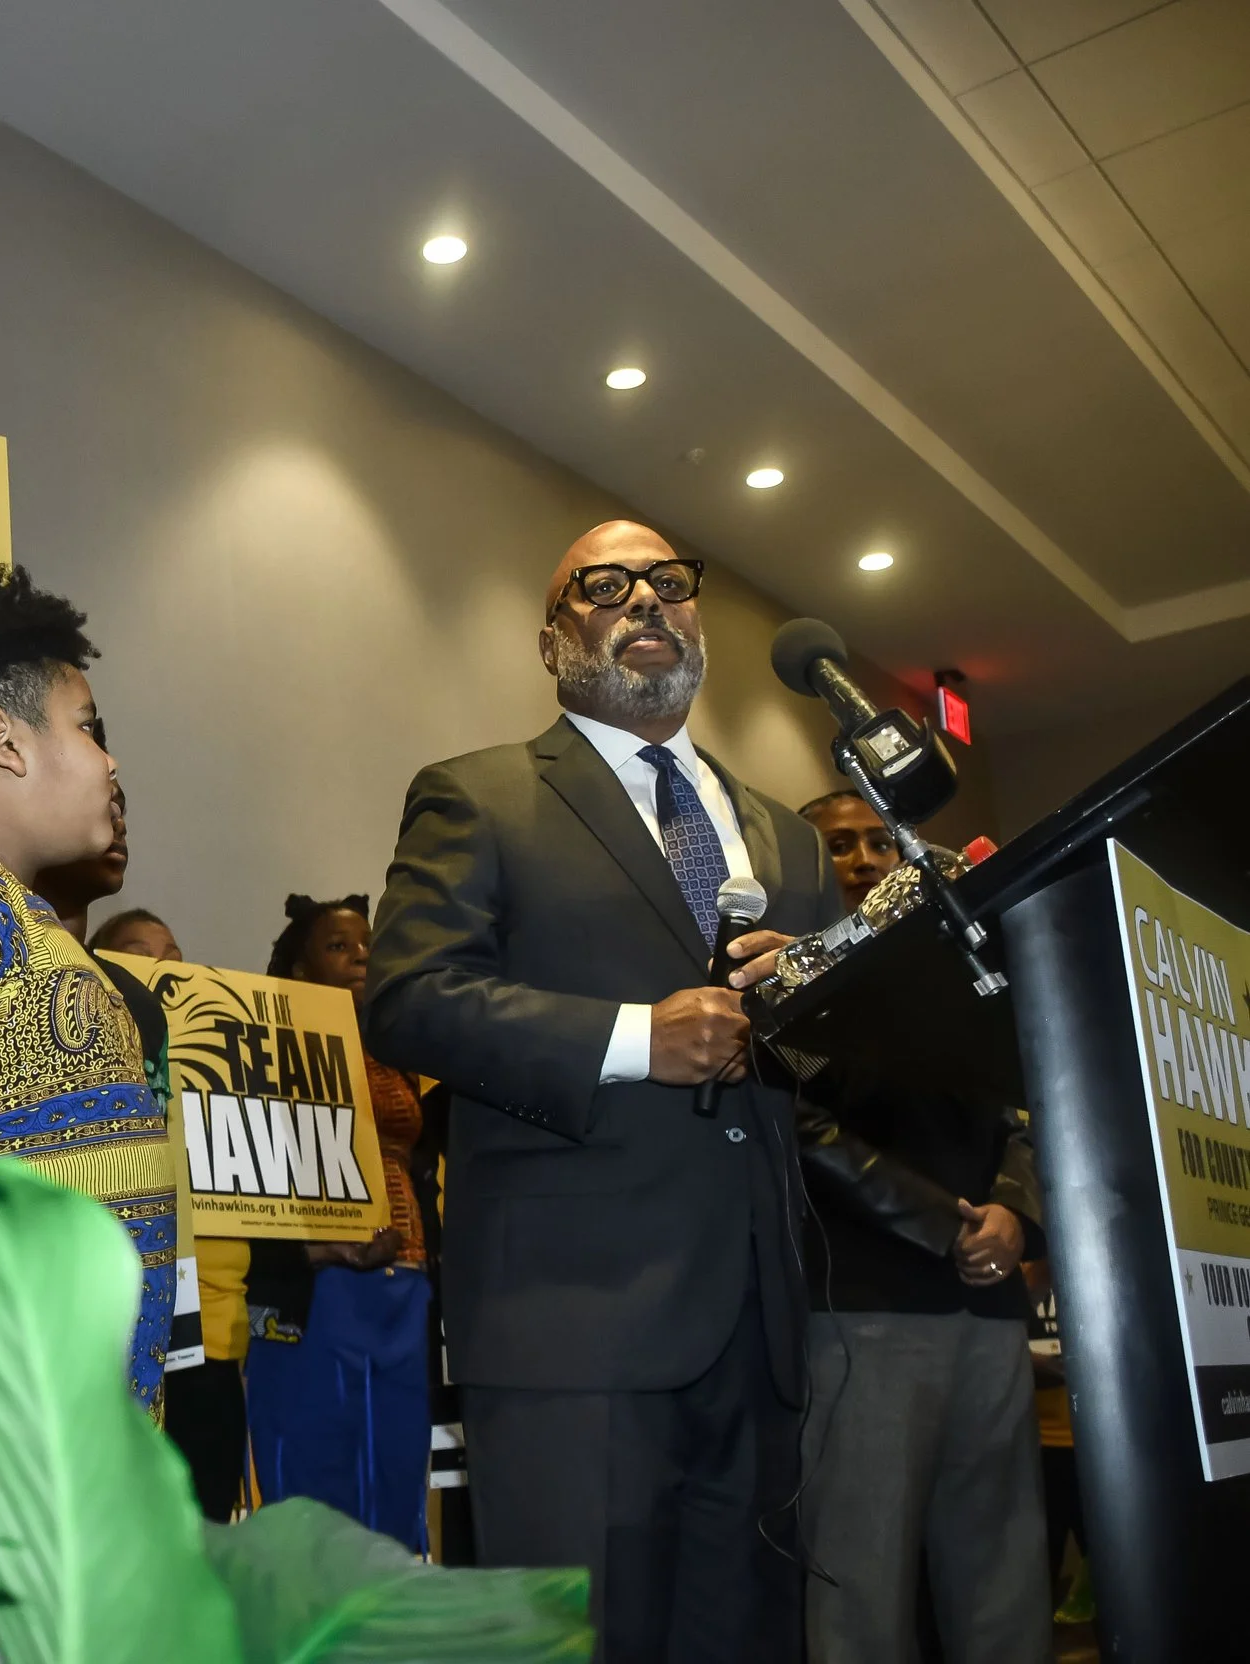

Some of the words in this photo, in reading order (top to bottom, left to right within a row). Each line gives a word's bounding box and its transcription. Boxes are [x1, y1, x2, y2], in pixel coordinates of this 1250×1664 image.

[1134, 905, 1235, 1026] CALVIN
[273, 993, 294, 1027] ARE
[215, 1018, 353, 1105] TEAM
[289, 1203, 362, 1219] #united4calvin
[1201, 1262, 1234, 1307] YOUR
